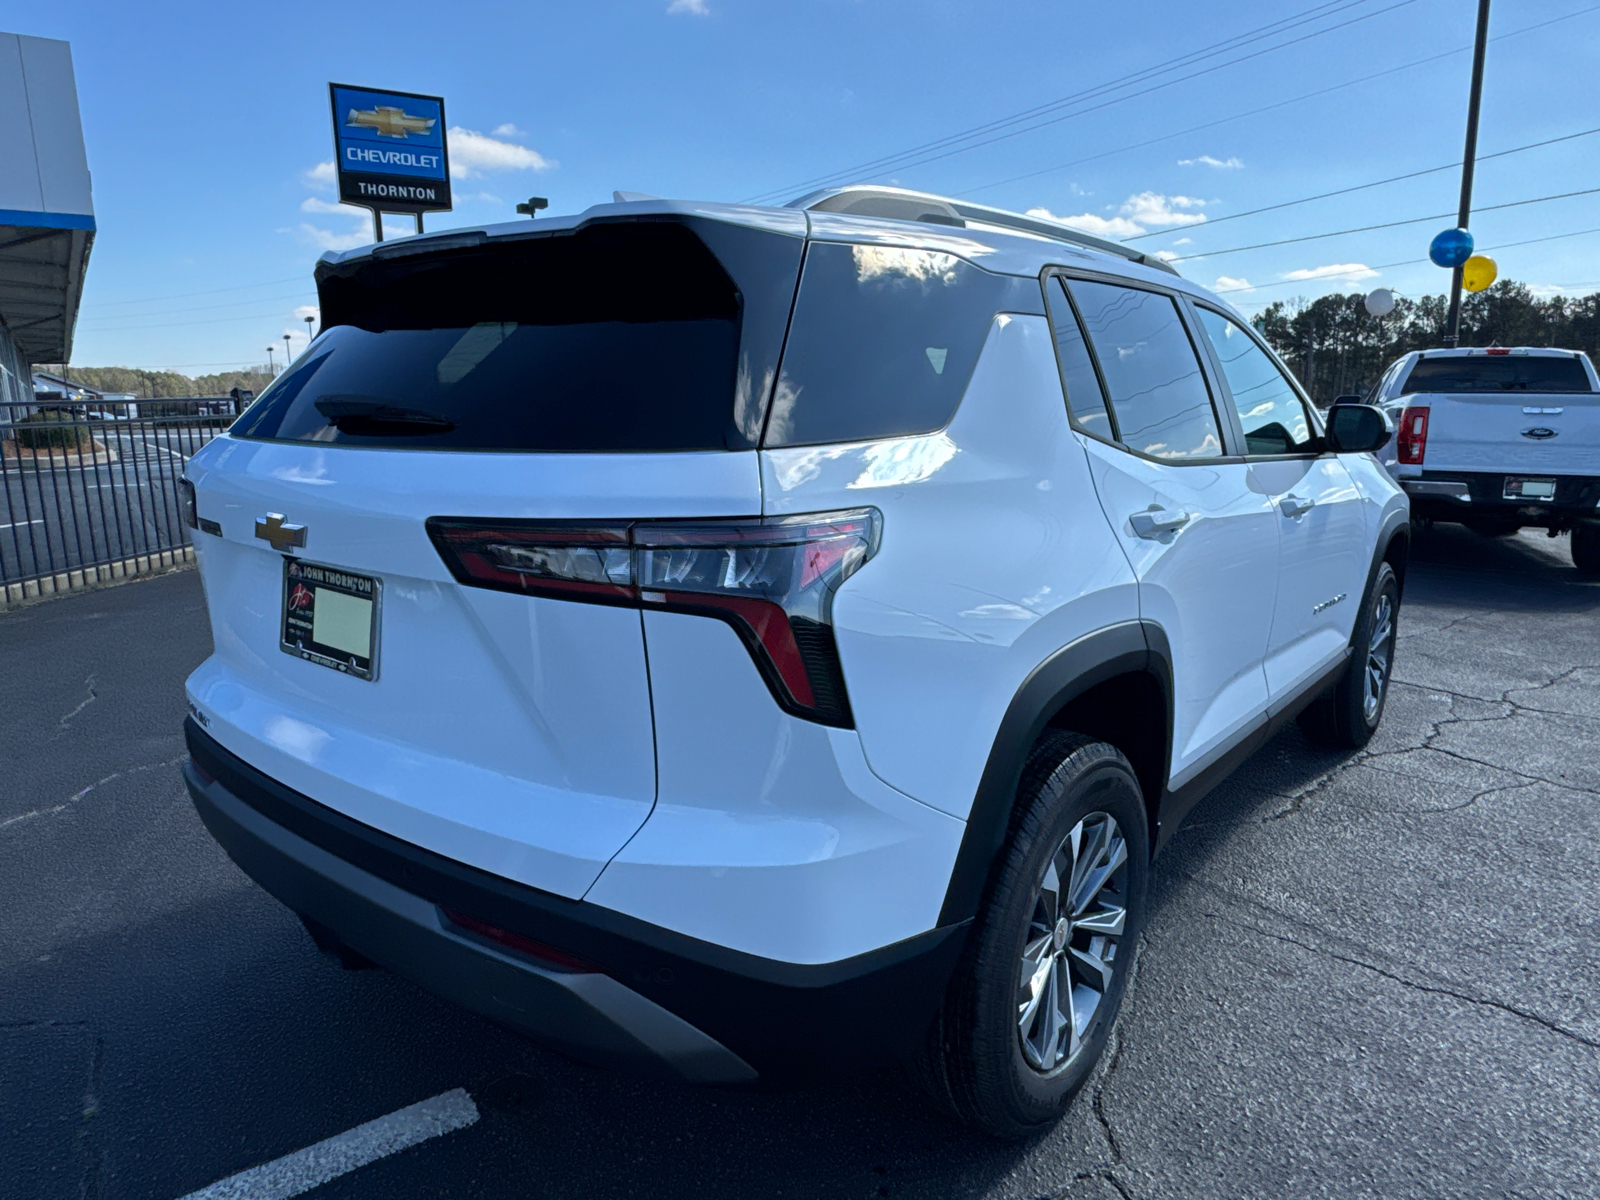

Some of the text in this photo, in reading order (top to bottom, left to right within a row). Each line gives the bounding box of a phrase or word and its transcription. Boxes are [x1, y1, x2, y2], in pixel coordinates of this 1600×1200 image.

[346, 147, 439, 168] CHEVROLET
[358, 182, 436, 200] THORNTON
[303, 566, 324, 582] JOHN
